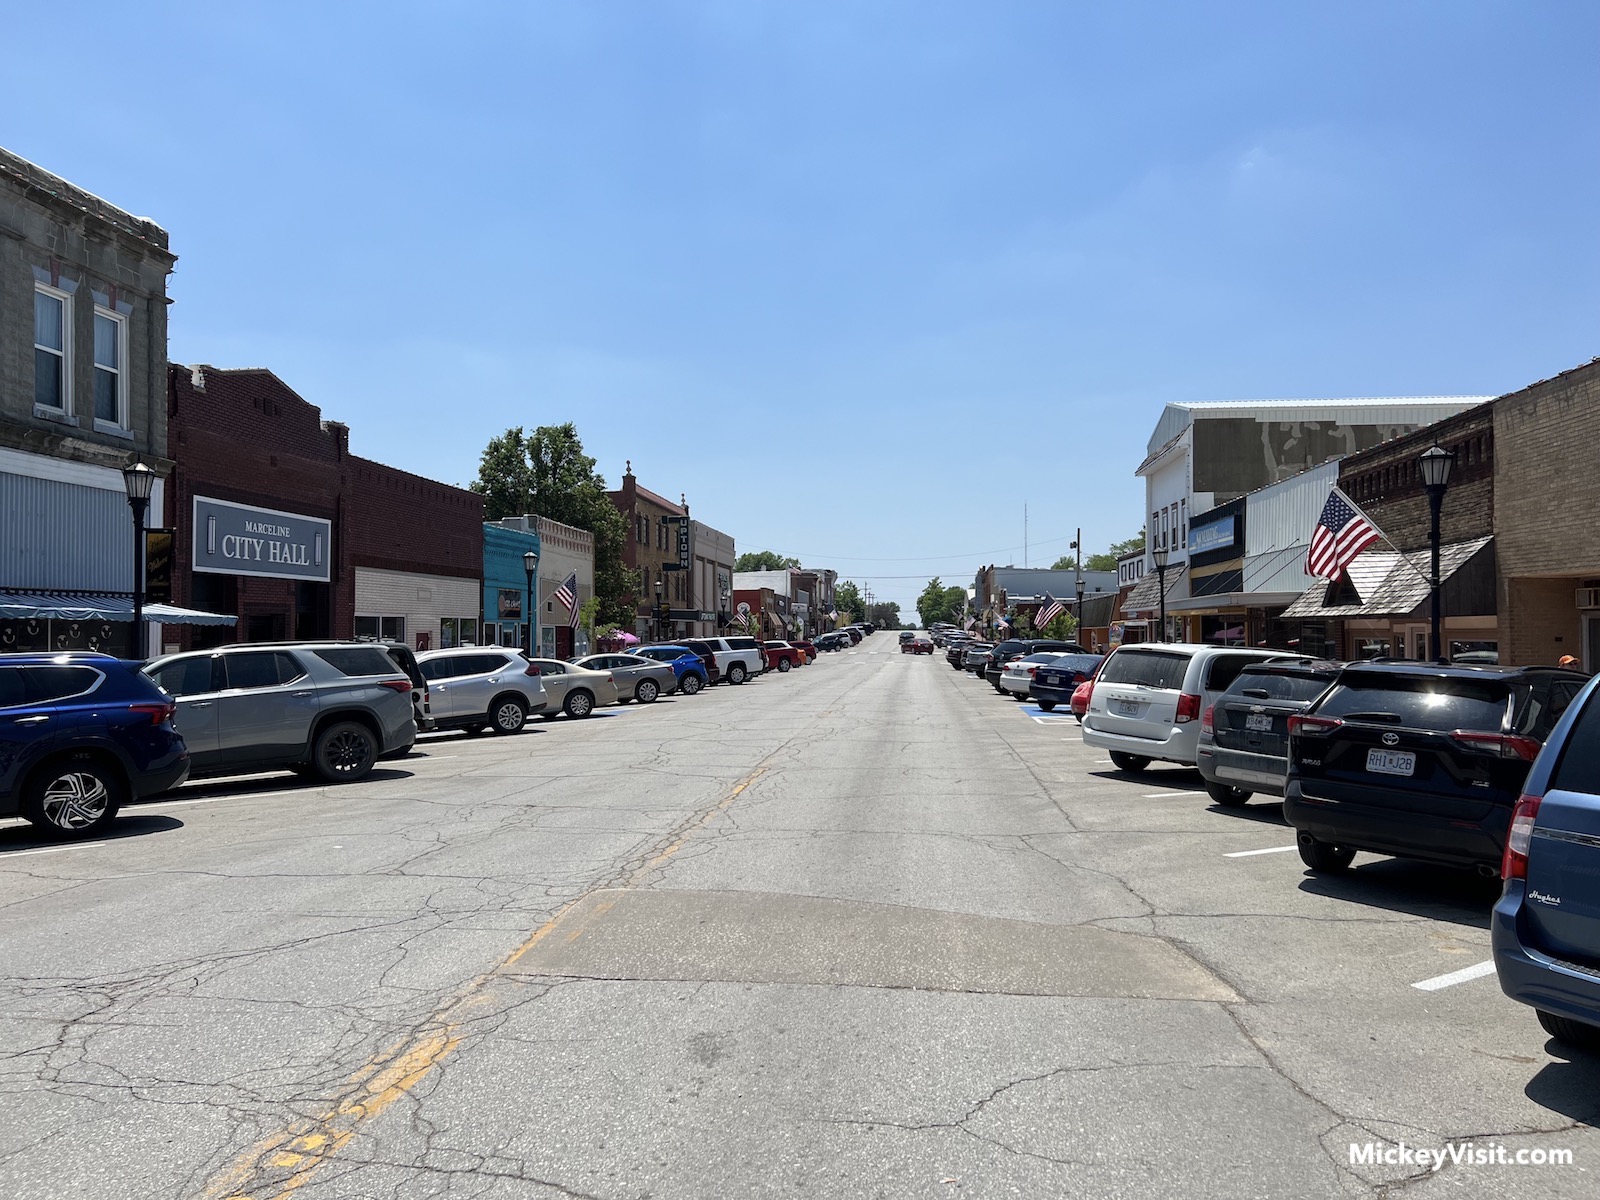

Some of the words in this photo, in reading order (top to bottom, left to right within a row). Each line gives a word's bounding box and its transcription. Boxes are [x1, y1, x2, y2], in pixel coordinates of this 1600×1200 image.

[245, 521, 291, 538] MARCELINE
[222, 534, 265, 561] CITY
[268, 540, 310, 566] HALL
[680, 519, 688, 568] UPTOWN
[1368, 753, 1387, 767] RH1
[1392, 757, 1413, 770] J2B
[1528, 889, 1561, 904] Hughes
